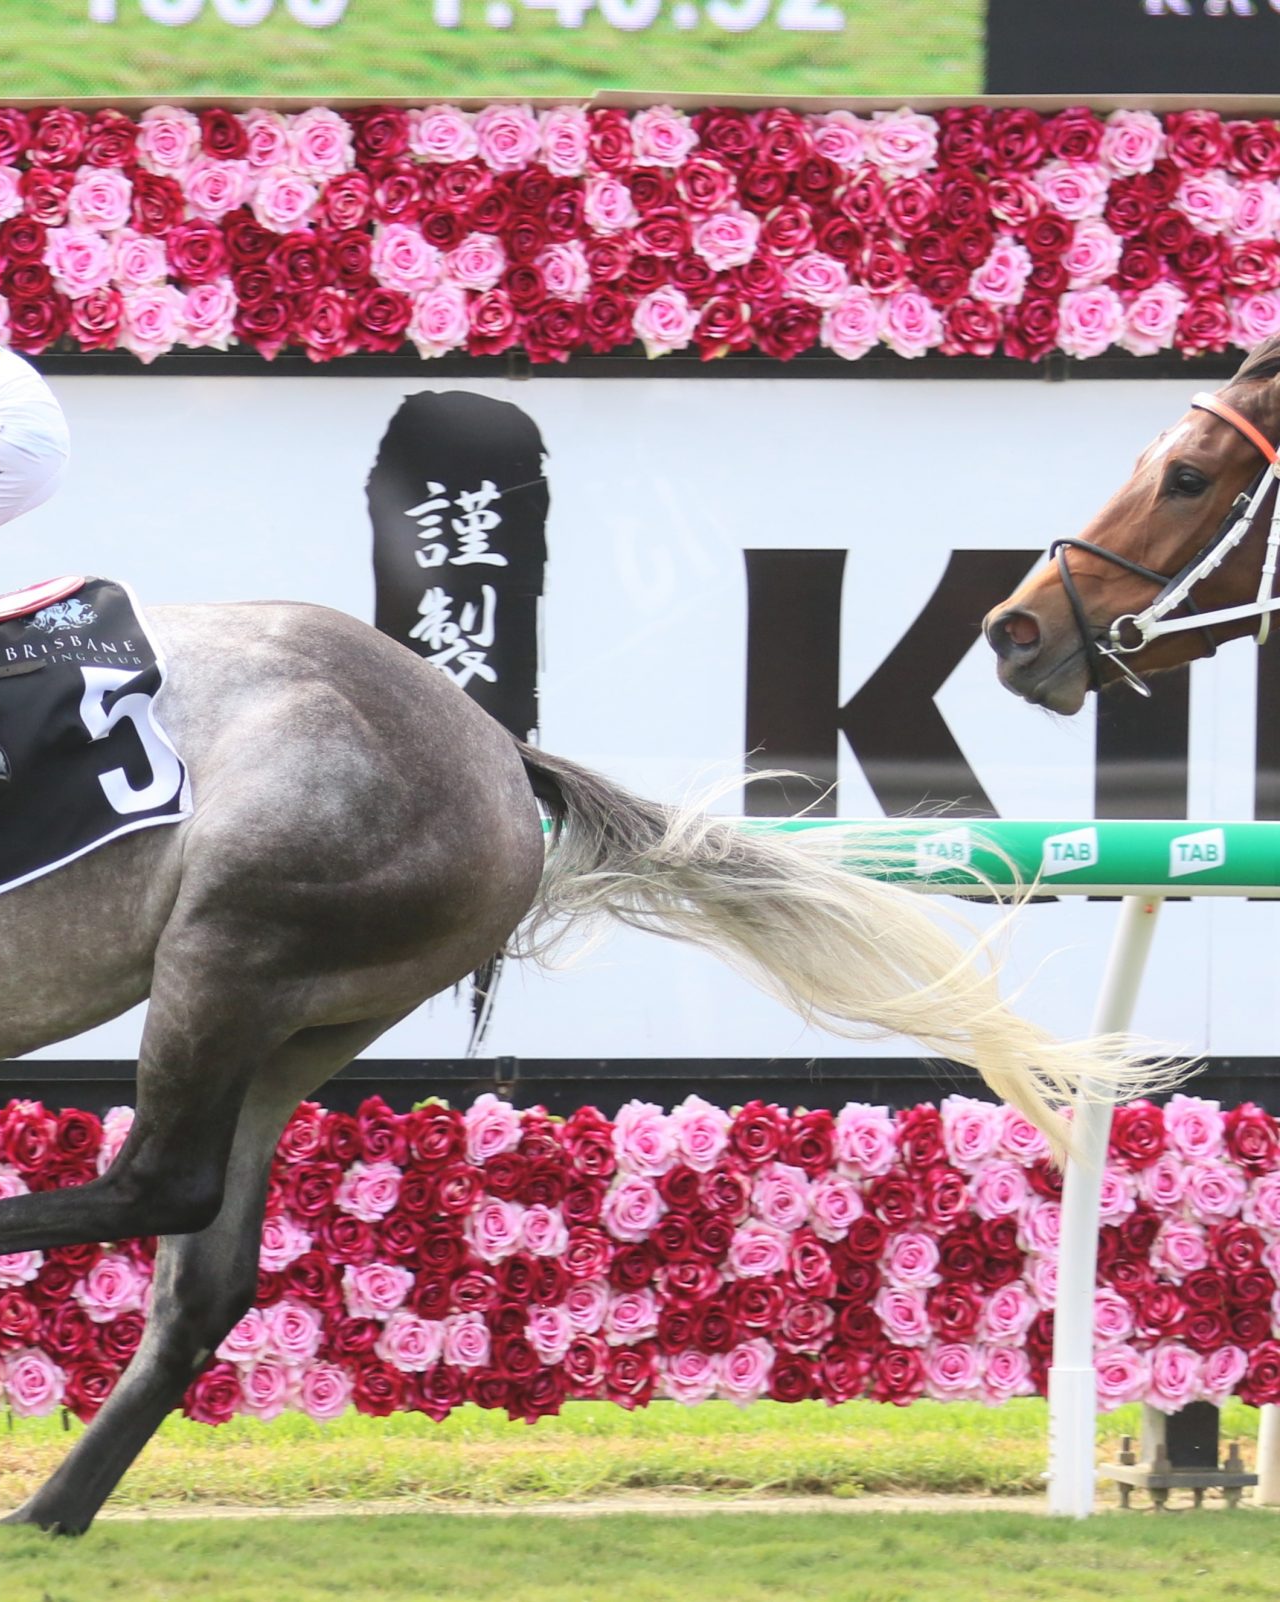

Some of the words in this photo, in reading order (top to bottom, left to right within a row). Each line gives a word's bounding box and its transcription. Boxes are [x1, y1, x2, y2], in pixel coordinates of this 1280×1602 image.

[403, 479, 509, 689] 謹製
[5, 635, 136, 661] BRISBANE
[80, 666, 181, 815] 5
[923, 842, 964, 861] TAB
[1051, 843, 1091, 862] TAB
[1177, 843, 1219, 862] TAB
